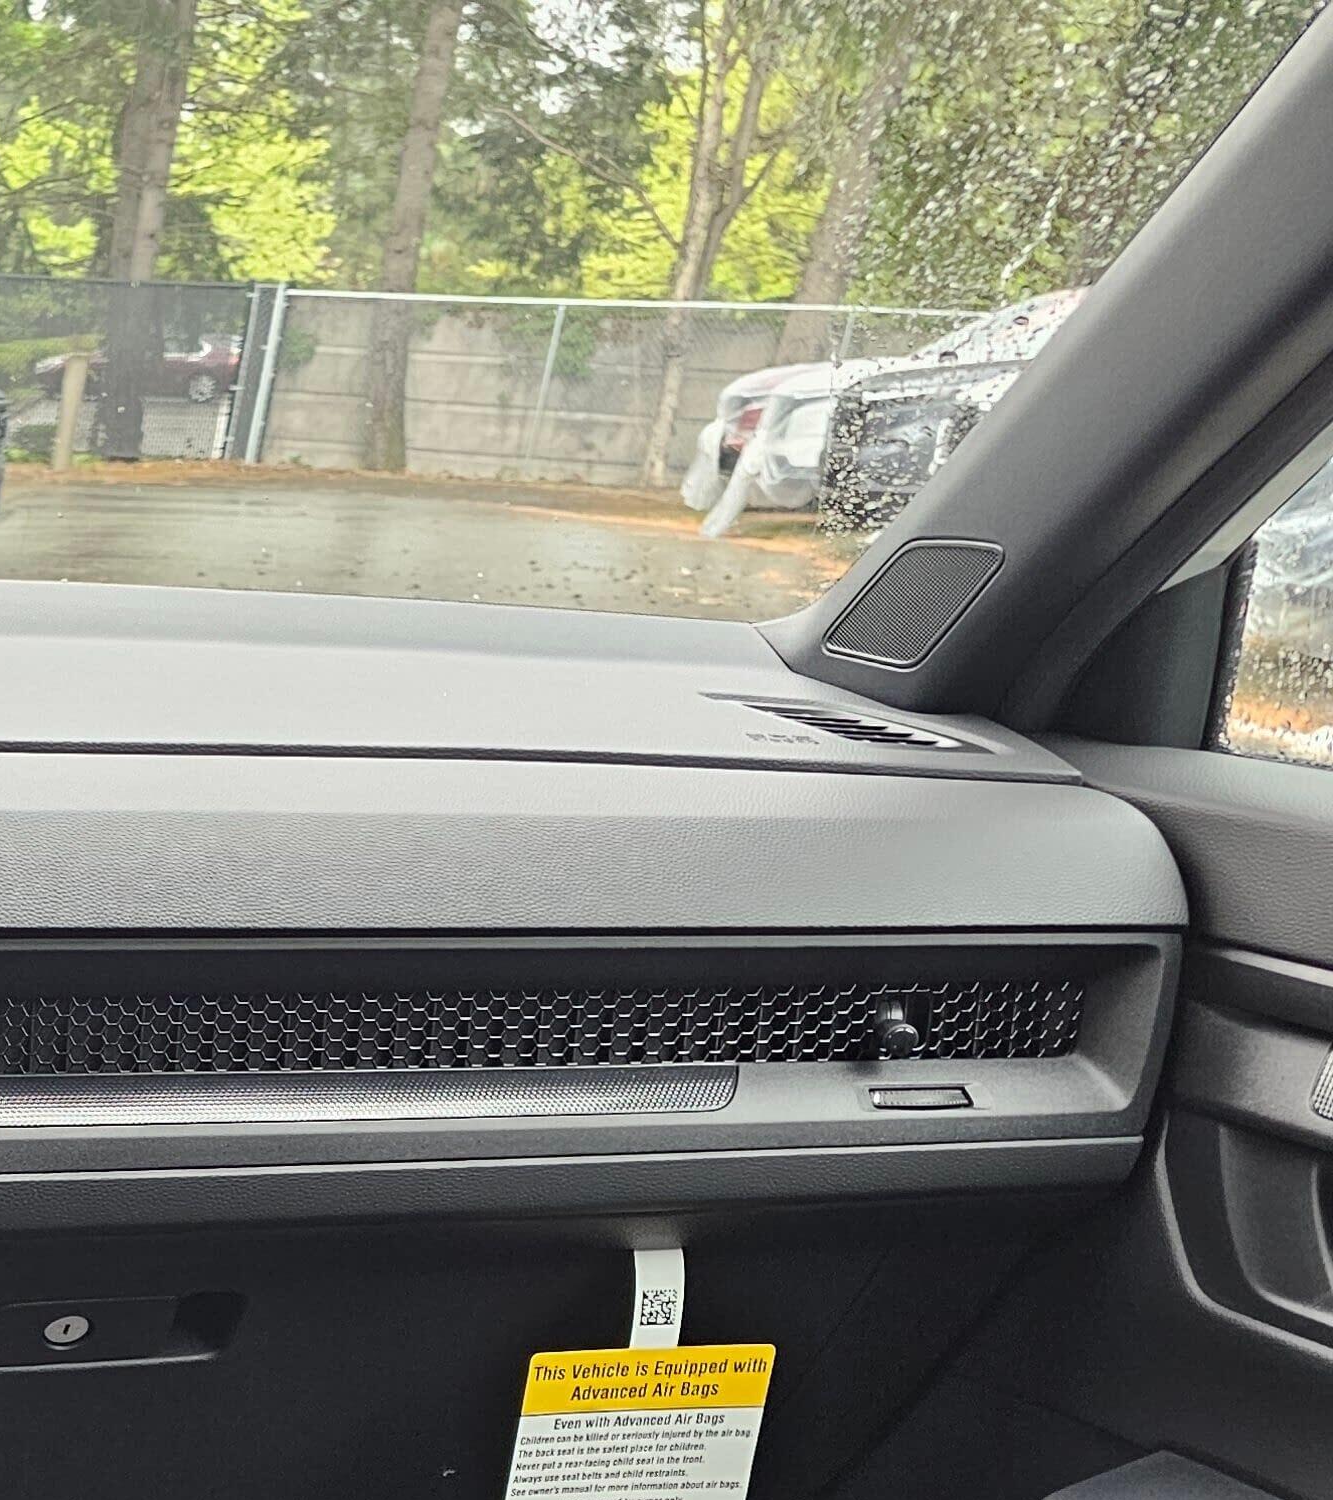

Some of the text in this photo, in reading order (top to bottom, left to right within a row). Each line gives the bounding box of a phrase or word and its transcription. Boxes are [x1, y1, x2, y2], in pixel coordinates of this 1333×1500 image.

[535, 1358, 767, 1381] This Vehicle is Equipped with
[570, 1381, 719, 1401] Advanced Air Bags
[554, 1412, 726, 1431] Even with Advanced Air Bags
[520, 1435, 555, 1446] Children
[556, 1435, 572, 1443] can
[573, 1433, 584, 1442] be
[586, 1432, 609, 1441] killed
[611, 1433, 620, 1441] or
[622, 1431, 659, 1441] seriously
[661, 1429, 691, 1440] injured
[693, 1429, 703, 1439] by
[705, 1429, 718, 1437] the
[721, 1429, 733, 1437] air
[518, 1450, 533, 1459] The
[535, 1448, 554, 1458] back
[557, 1447, 575, 1456] seat
[577, 1447, 585, 1455] is
[587, 1446, 600, 1454] the
[602, 1445, 628, 1454] safest
[630, 1444, 653, 1454] place
[655, 1443, 668, 1452] for
[515, 1462, 540, 1471] Never
[542, 1461, 555, 1471] put
[613, 1457, 634, 1466] child
[636, 1456, 654, 1465] seat
[656, 1456, 665, 1464] in
[667, 1455, 680, 1464] the
[512, 1475, 542, 1485] Always
[544, 1474, 559, 1482] use
[562, 1473, 580, 1482] seat
[581, 1472, 602, 1481] belts
[604, 1470, 621, 1479] and
[622, 1469, 644, 1478] child
[510, 1488, 526, 1497] See
[528, 1486, 559, 1495] owner's
[561, 1484, 593, 1494] manual
[594, 1484, 606, 1493] for
[607, 1483, 629, 1492] more
[631, 1482, 678, 1491] information
[680, 1481, 705, 1490] about
[705, 1480, 718, 1489] air
